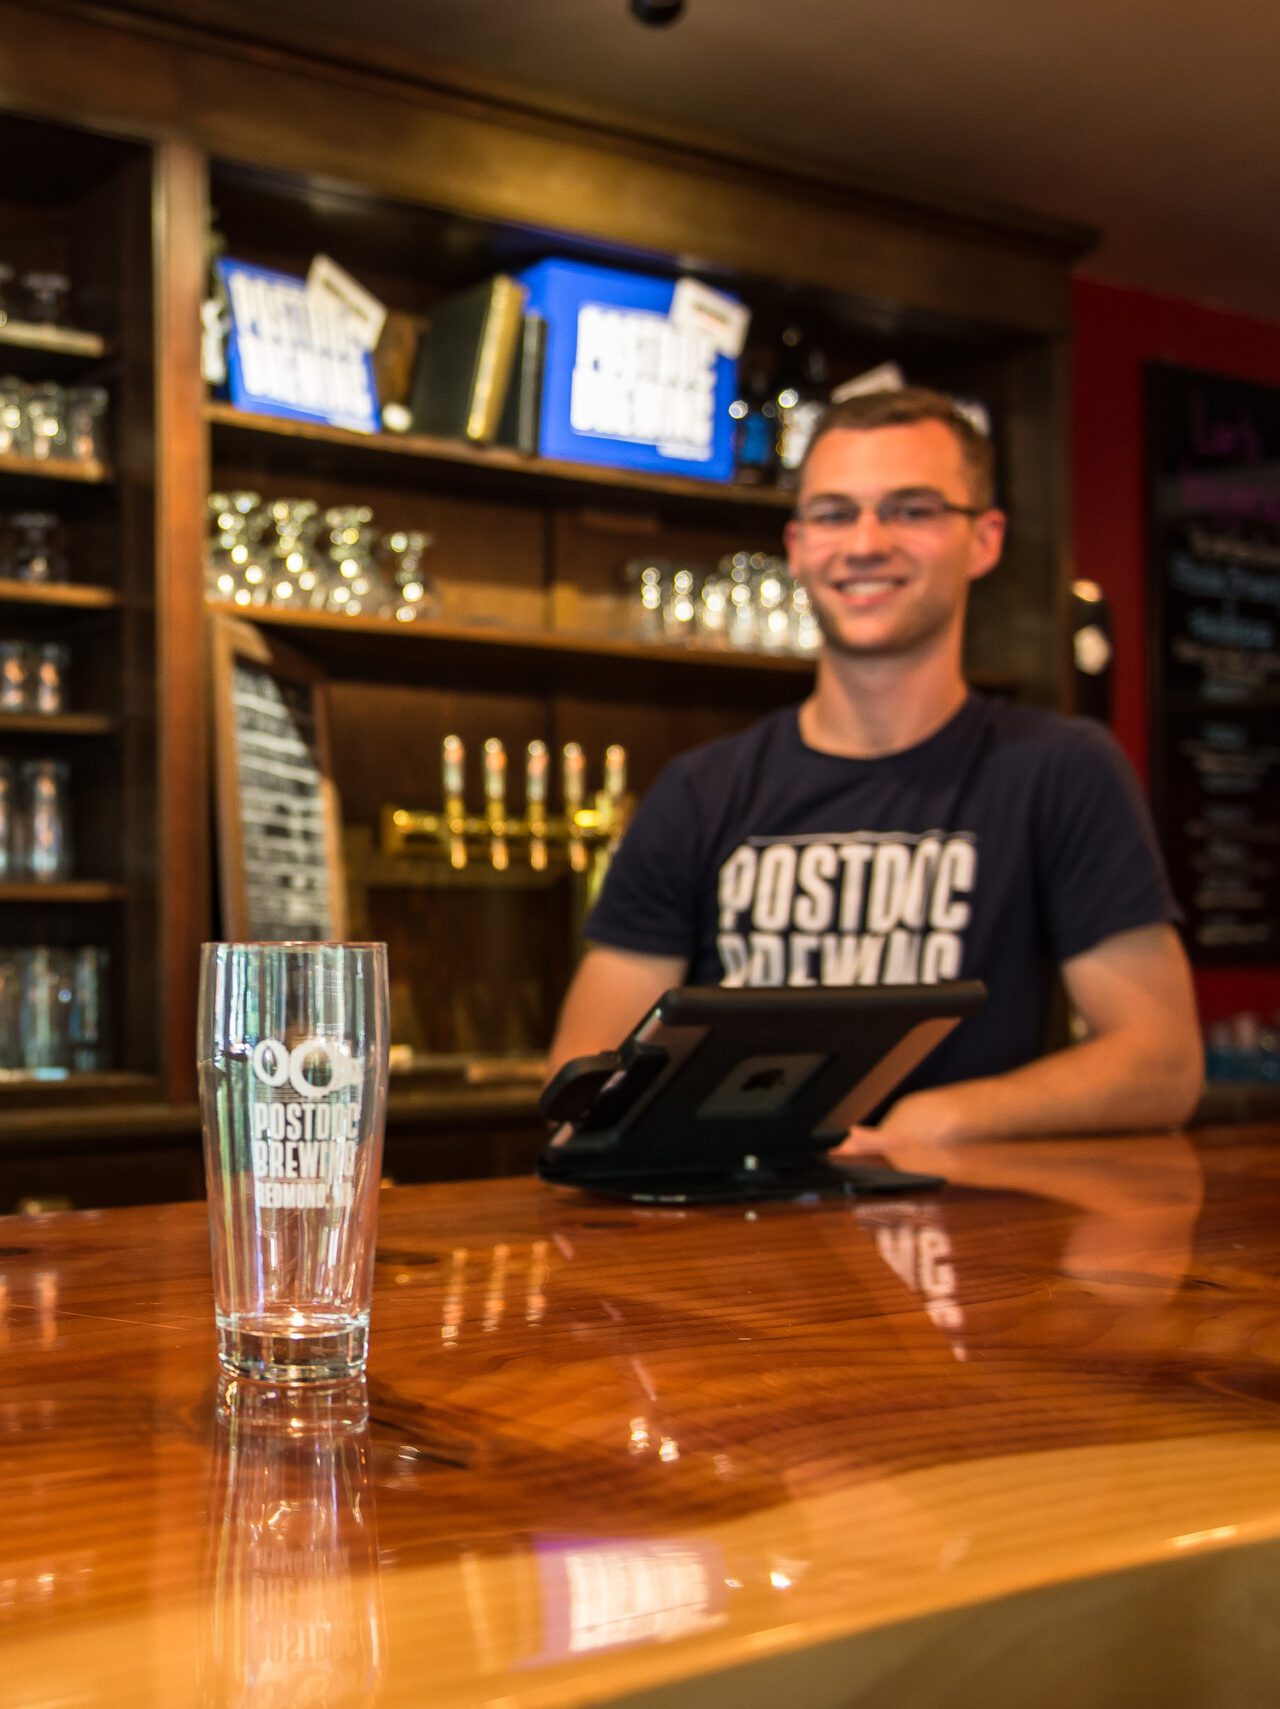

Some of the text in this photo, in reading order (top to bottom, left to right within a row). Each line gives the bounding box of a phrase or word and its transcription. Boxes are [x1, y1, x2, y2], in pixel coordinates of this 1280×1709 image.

[718, 838, 977, 934] POSTDOC
[254, 1102, 361, 1141] POSTDOC
[254, 1140, 357, 1179] BREWING
